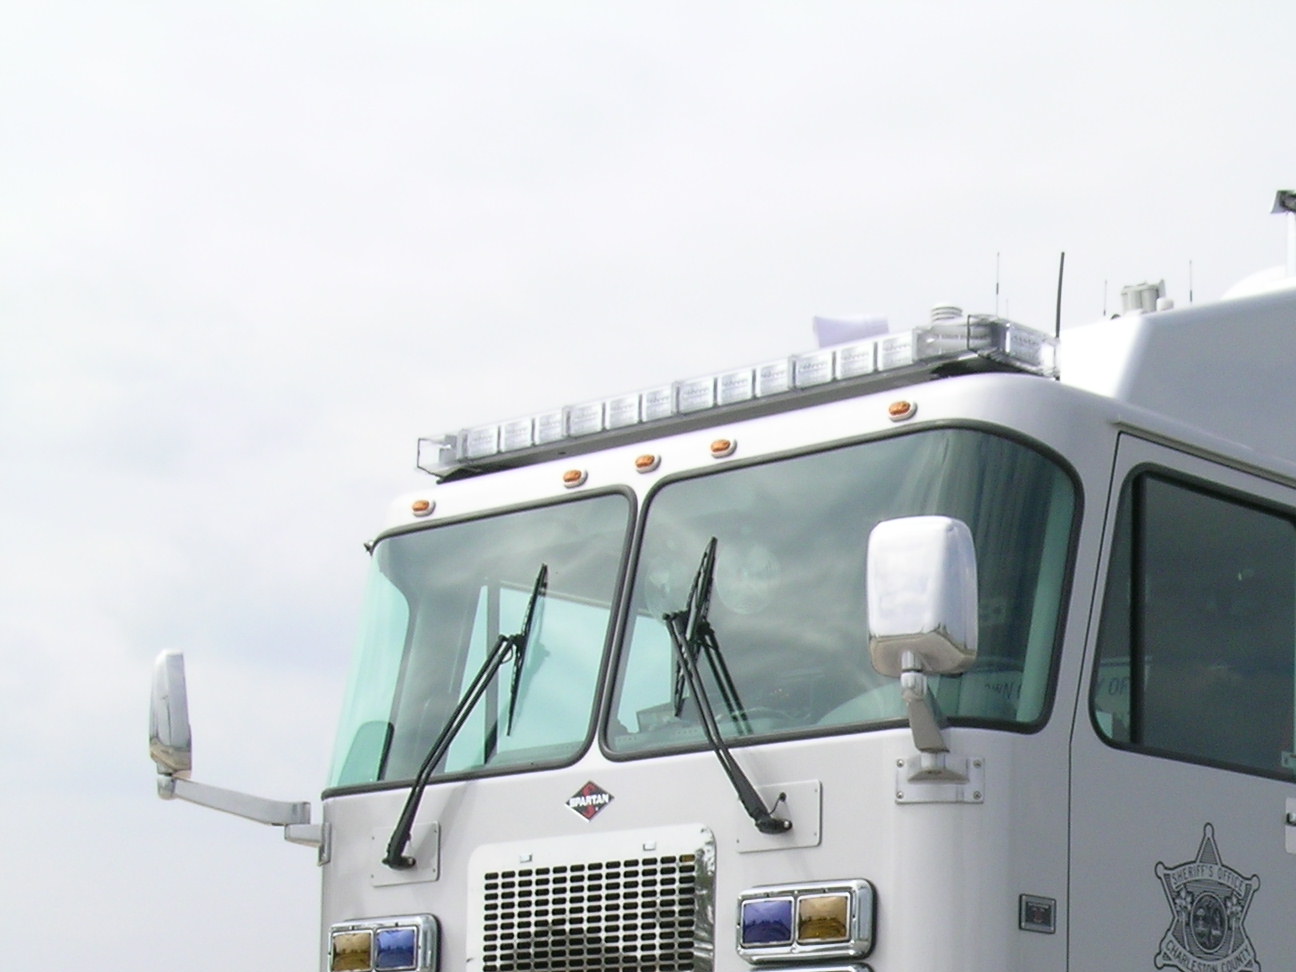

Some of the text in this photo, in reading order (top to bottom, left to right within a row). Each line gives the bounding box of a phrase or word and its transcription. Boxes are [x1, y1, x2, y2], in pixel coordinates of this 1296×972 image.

[569, 794, 609, 808] SPARTAN
[1172, 865, 1244, 892] SHERIFF'S OFFICE
